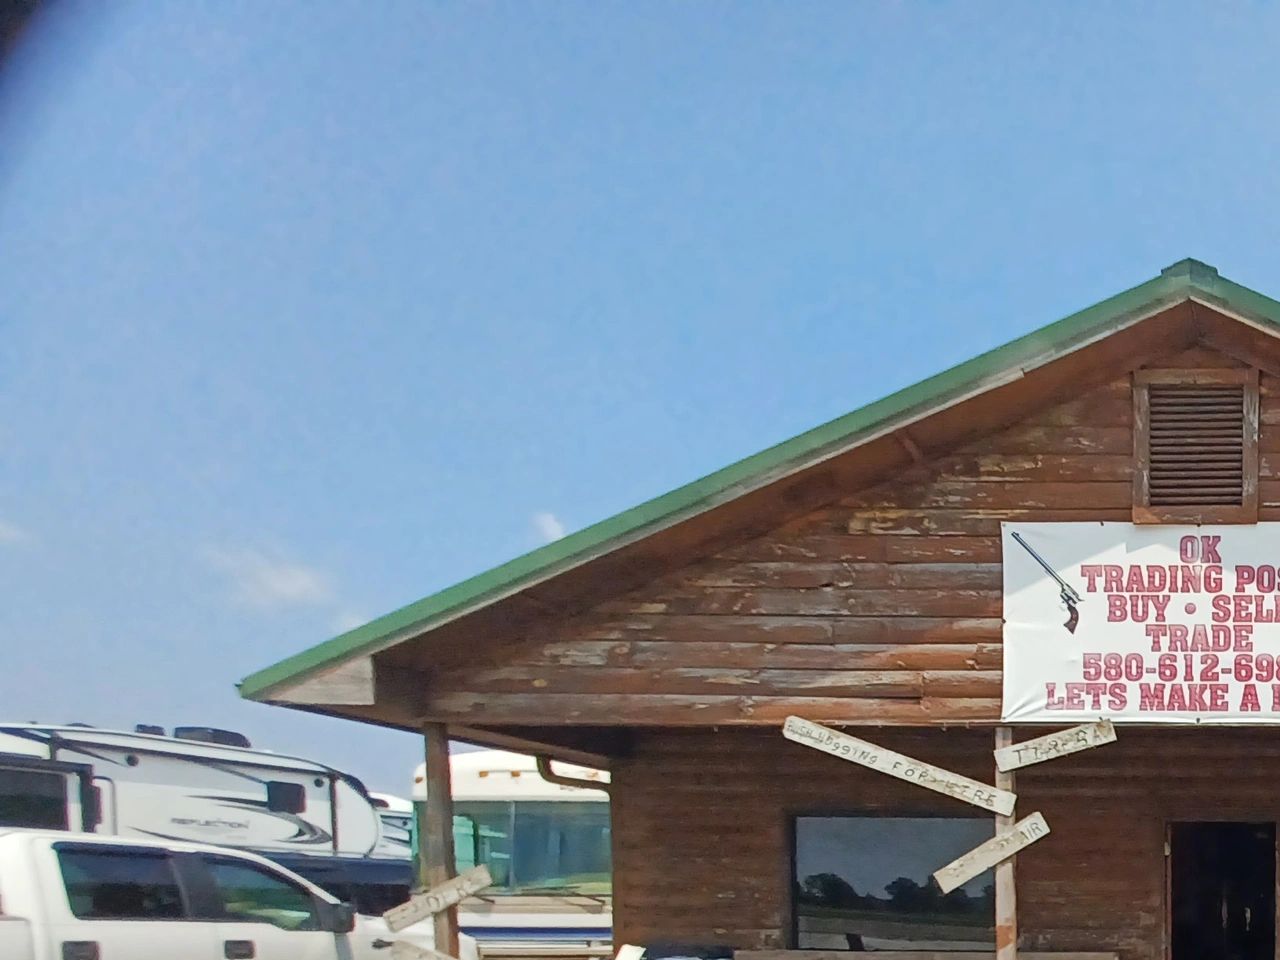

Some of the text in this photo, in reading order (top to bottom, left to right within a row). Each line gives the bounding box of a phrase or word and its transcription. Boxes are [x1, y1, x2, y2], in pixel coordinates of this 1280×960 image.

[1179, 535, 1222, 564] OK
[1080, 565, 1223, 594] TRADING
[1107, 595, 1171, 624] BUY
[1145, 624, 1254, 653] TRADE
[1045, 682, 1128, 711] LETS
[1139, 682, 1229, 712] MAKE
[1239, 682, 1261, 712] A
